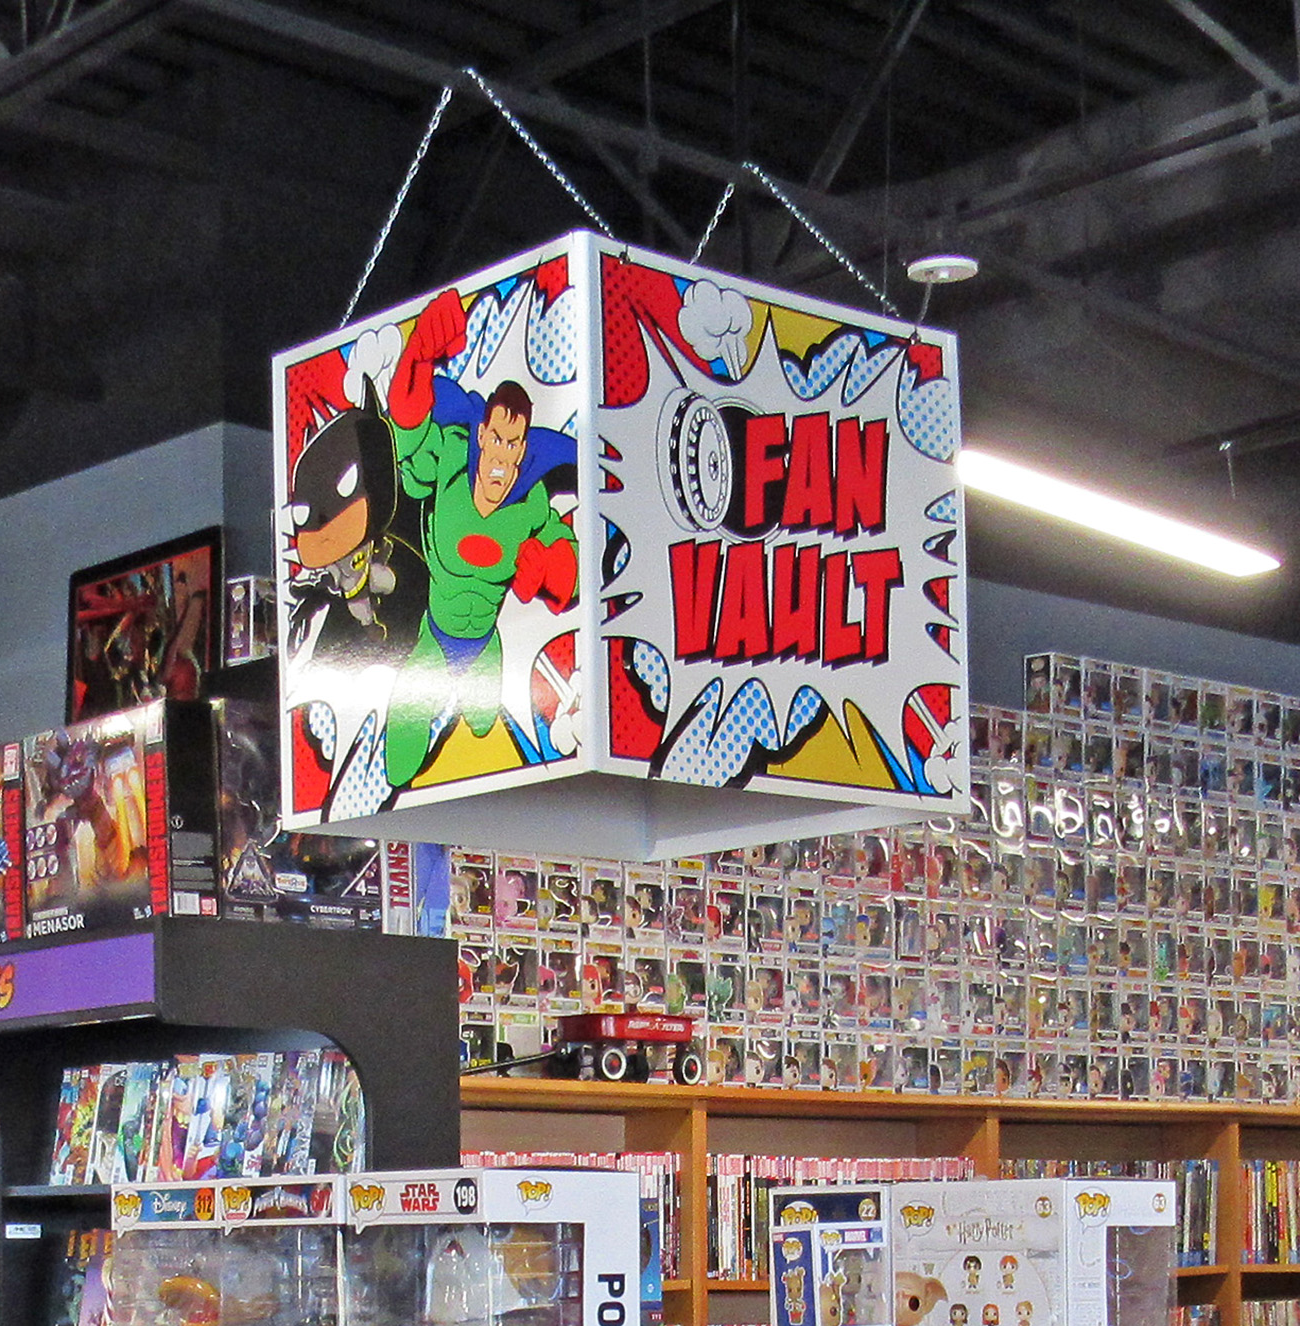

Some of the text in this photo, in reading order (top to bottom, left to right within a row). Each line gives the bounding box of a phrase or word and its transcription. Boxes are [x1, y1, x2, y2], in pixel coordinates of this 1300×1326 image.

[745, 412, 889, 538] FAN
[669, 540, 902, 667] VAULT
[147, 751, 167, 914] TRANSFORMERS
[33, 914, 84, 936] MENASOR
[350, 1184, 385, 1212] POP!
[401, 1184, 439, 1197] STAR
[456, 1186, 476, 1208] 198
[517, 1181, 552, 1201] POP!
[152, 1190, 187, 1220] Disney
[196, 1194, 212, 1213] 312
[401, 1198, 439, 1212] WARS
[861, 1203, 876, 1217] 22
[1037, 1202, 1051, 1214] 63
[1075, 1192, 1111, 1217] POP!
[900, 1206, 934, 1228] POP!
